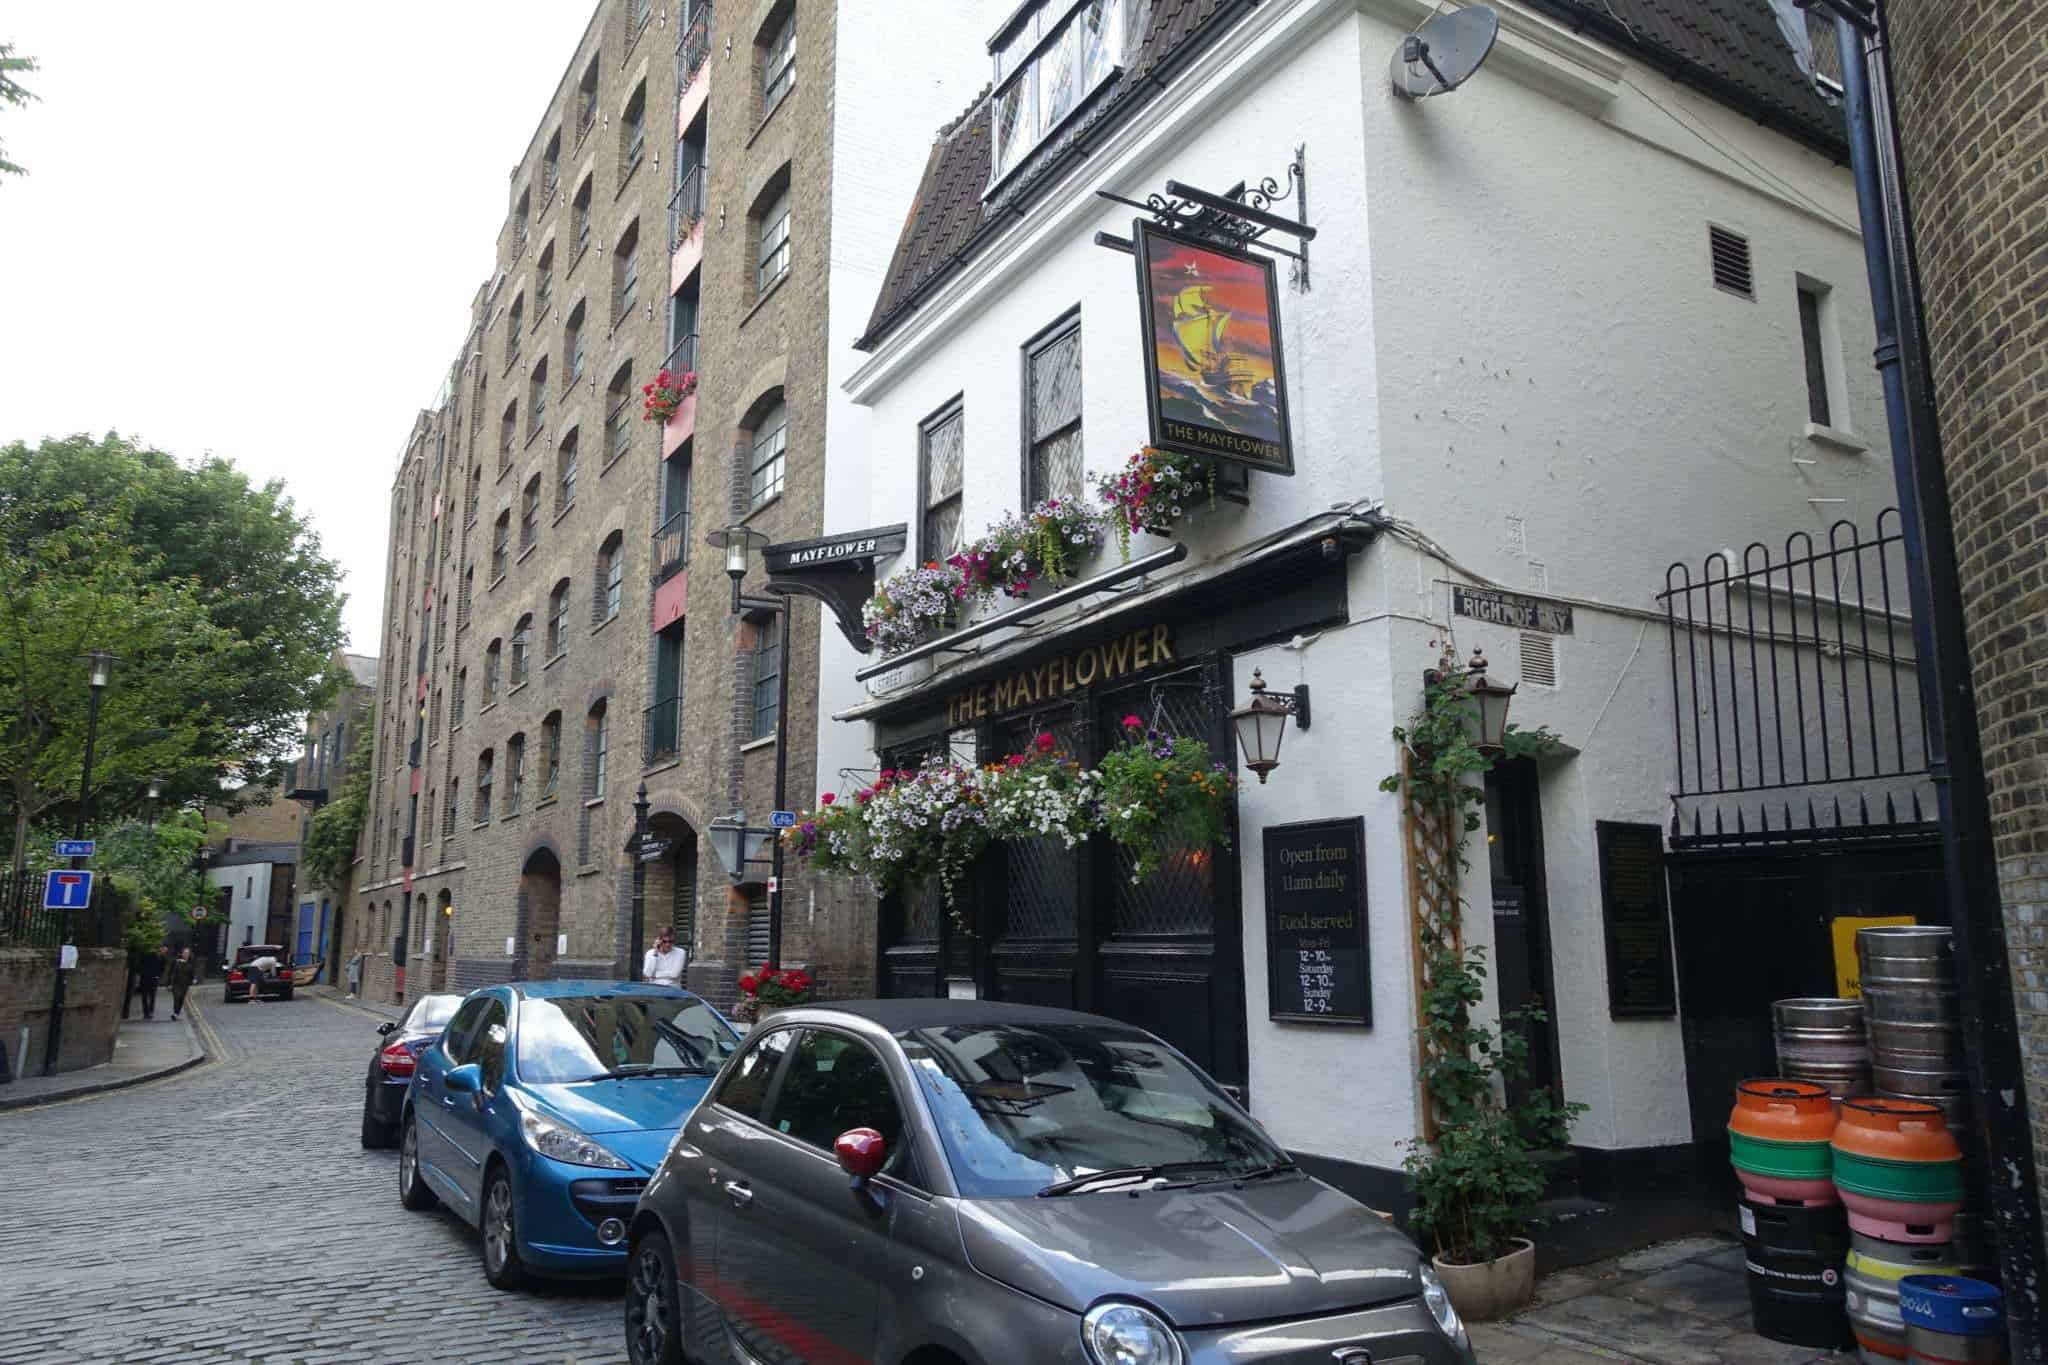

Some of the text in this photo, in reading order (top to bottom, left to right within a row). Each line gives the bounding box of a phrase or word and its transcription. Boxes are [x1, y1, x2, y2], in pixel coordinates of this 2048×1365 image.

[1168, 423, 1281, 458] THE MAYFLOWER
[790, 540, 876, 564] MAYFLOWER
[945, 624, 1173, 724] THE MAYFLOWER
[1279, 842, 1347, 867] Open from
[1283, 869, 1346, 892] 11am daily
[1280, 909, 1353, 930] Food served
[1299, 963, 1334, 976] Saturday
[1303, 986, 1331, 1000] Sunday
